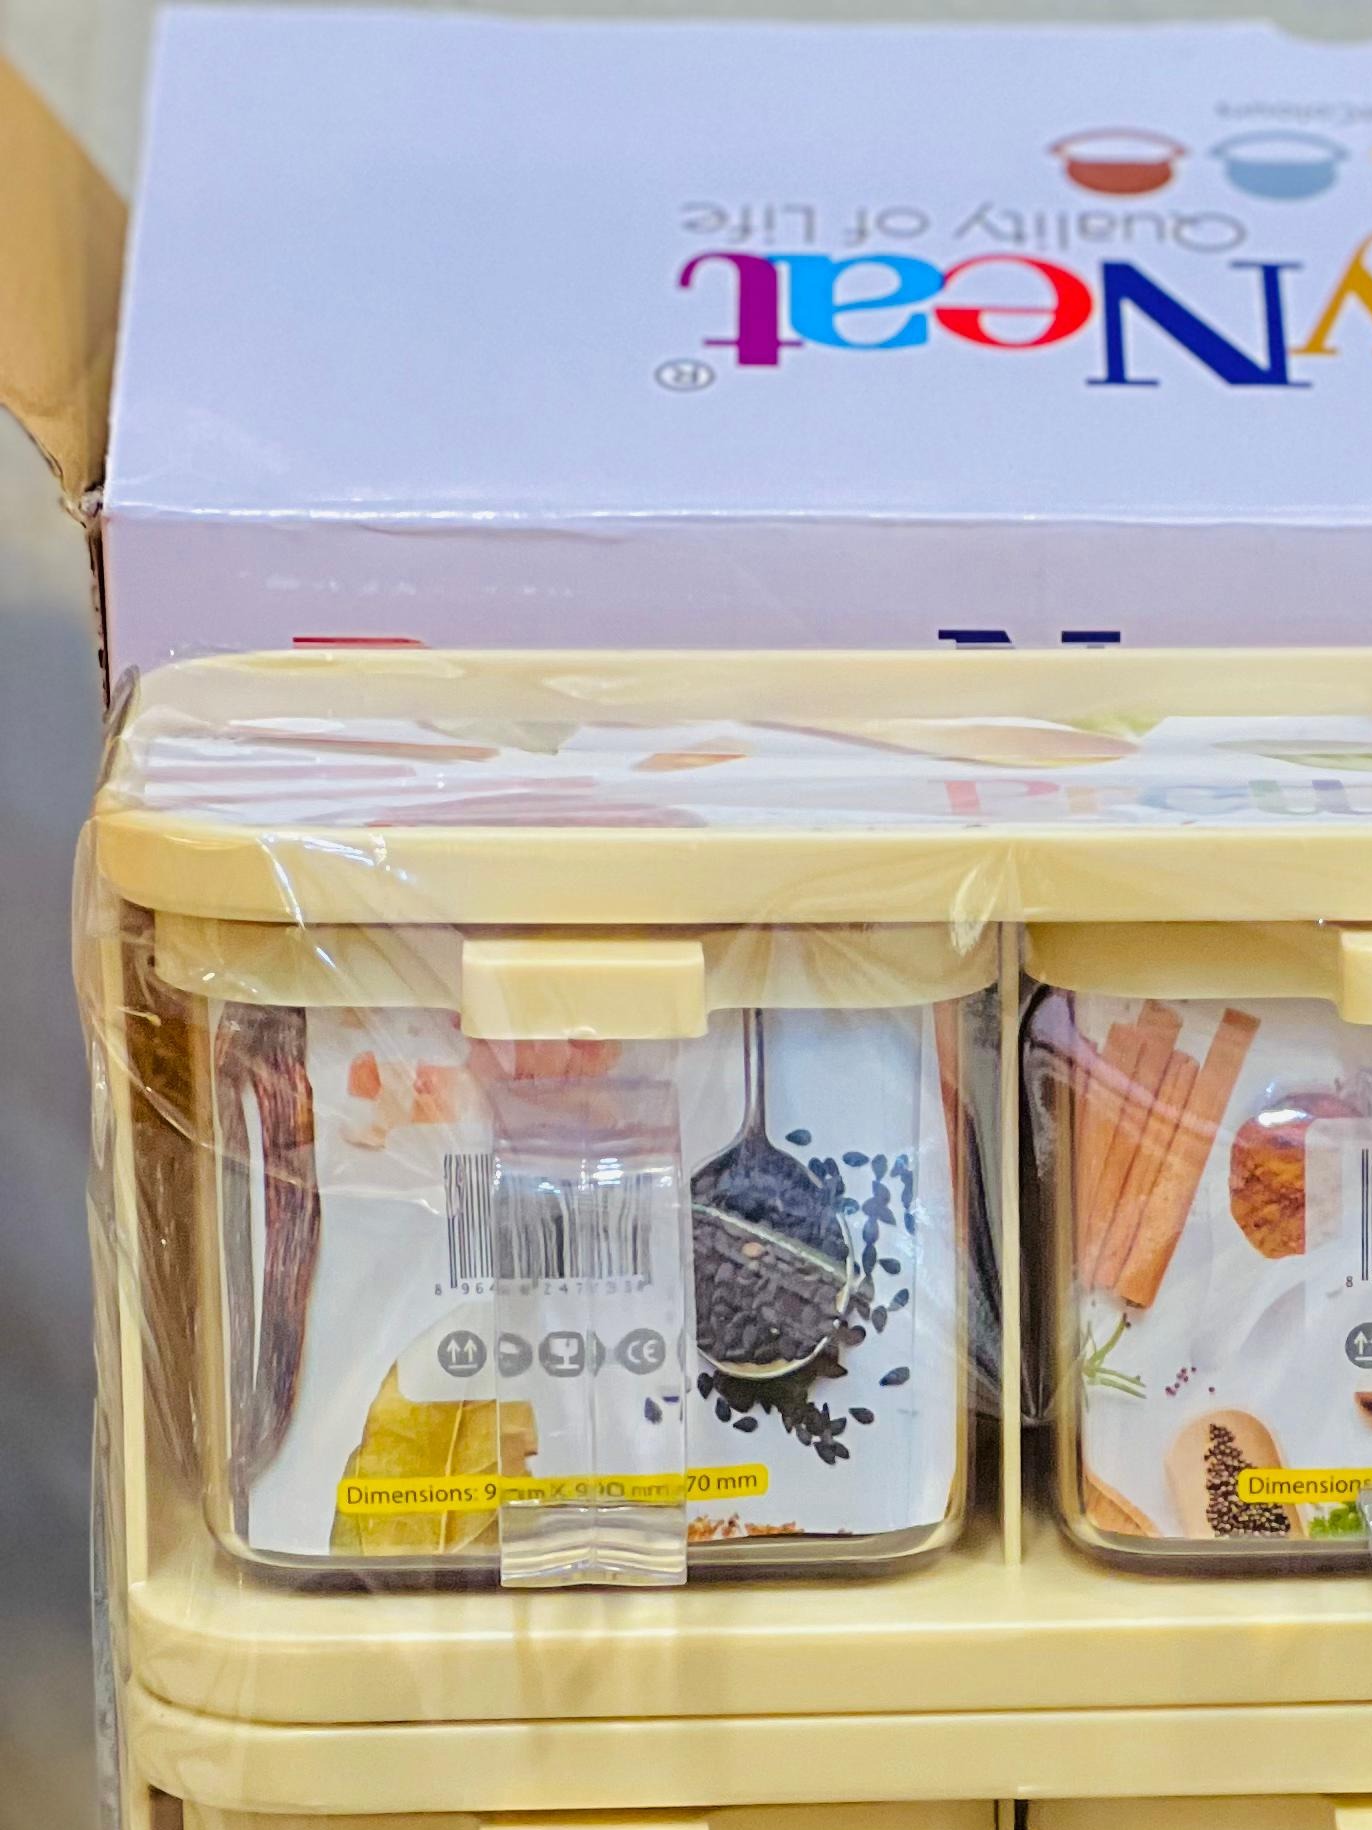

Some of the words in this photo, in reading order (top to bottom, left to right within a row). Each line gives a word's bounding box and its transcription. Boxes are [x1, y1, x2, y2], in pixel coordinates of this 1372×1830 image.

[680, 200, 818, 243] Life
[840, 202, 931, 248] of
[952, 200, 1248, 252] Quality
[688, 1474, 711, 1492] 70
[717, 1473, 758, 1490] mm
